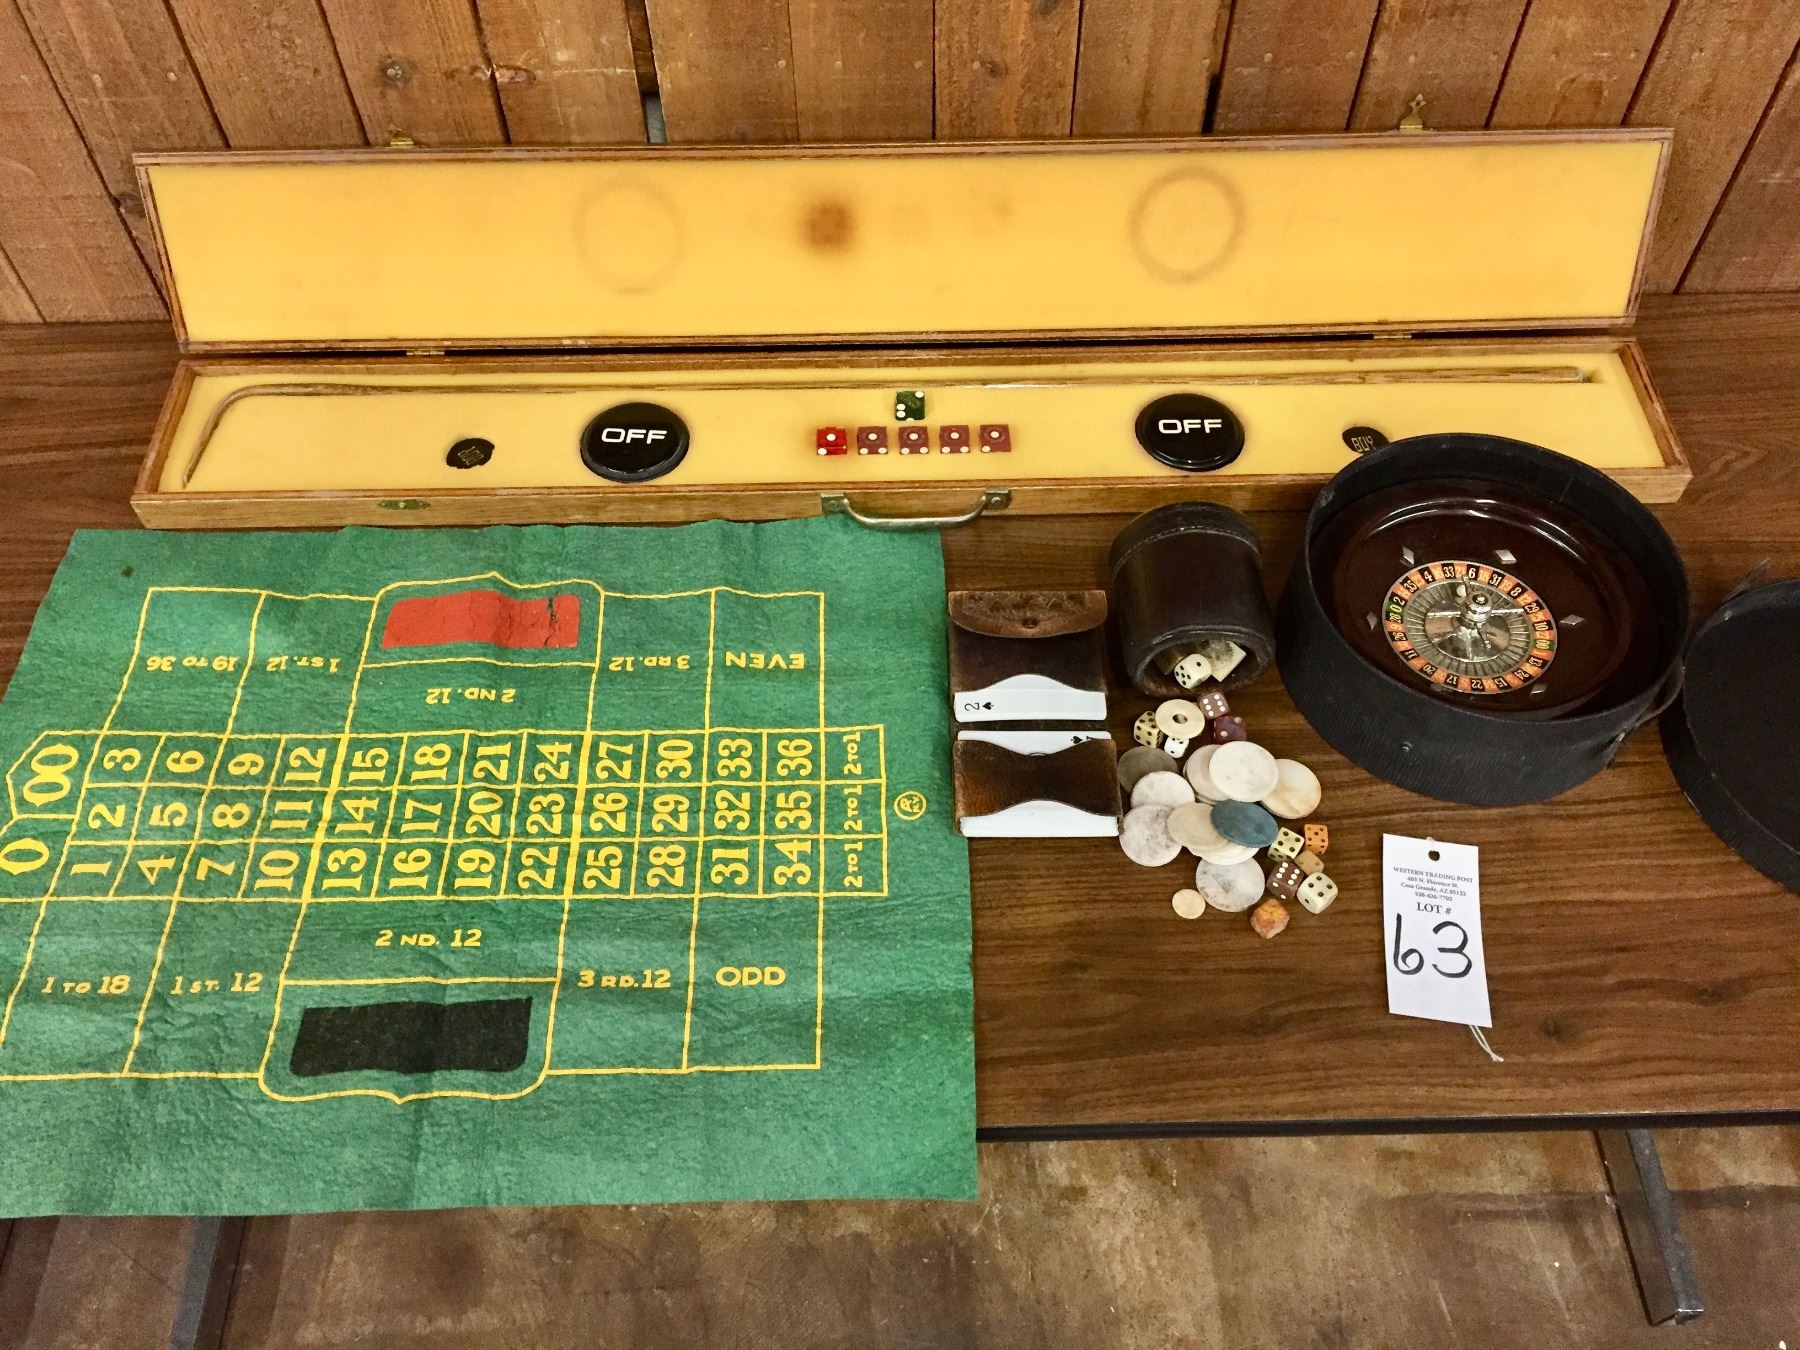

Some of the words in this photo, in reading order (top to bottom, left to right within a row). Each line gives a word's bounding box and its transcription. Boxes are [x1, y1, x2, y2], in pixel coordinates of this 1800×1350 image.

[601, 427, 668, 445] OFF
[1158, 419, 1222, 434] OFF
[1424, 571, 1433, 581] 4
[1444, 566, 1455, 577] 33
[1469, 568, 1476, 579] 6
[1489, 574, 1502, 586] 31
[1404, 581, 1418, 593] 35
[1511, 587, 1522, 597] 8
[1390, 604, 1402, 613] 0
[1394, 597, 1405, 606] 2
[1525, 602, 1539, 614] 29
[1535, 622, 1549, 631] 10
[146, 656, 176, 672] 36
[211, 656, 238, 672] 19
[266, 656, 289, 672] 12
[329, 657, 340, 673] 1
[676, 655, 690, 670] 3
[725, 652, 805, 669] EVEN
[426, 688, 452, 704] 12
[501, 689, 516, 703] 2
[1471, 680, 1483, 689] 22
[964, 702, 980, 711] 2
[103, 748, 141, 770] 3
[166, 749, 204, 773] 6
[227, 752, 264, 775] 9
[284, 746, 325, 781] 12
[348, 747, 389, 782] 15
[410, 743, 451, 782] 18
[472, 742, 511, 781] 21
[533, 742, 571, 782] 24
[596, 741, 633, 779] 27
[655, 739, 693, 779] 30
[716, 738, 752, 779] 33
[776, 738, 812, 776] 36
[21, 743, 79, 805] 00
[88, 803, 125, 828] 2
[148, 802, 188, 827] 5
[212, 802, 250, 828] 8
[270, 799, 312, 829] 11
[335, 797, 379, 832] 14
[400, 798, 442, 832] 17
[465, 790, 503, 835] 20
[526, 792, 564, 834] 23
[589, 791, 627, 832] 26
[651, 793, 688, 832] 29
[713, 790, 750, 830] 32
[775, 790, 811, 829] 35
[0, 837, 49, 874] 0
[517, 846, 559, 888] 22
[582, 845, 622, 888] 25
[646, 844, 686, 887] 28
[711, 847, 748, 884] 31
[773, 837, 812, 885] 34
[69, 861, 111, 875] 1
[136, 855, 176, 884] 4
[196, 857, 235, 880] 7
[254, 849, 299, 890] 10
[322, 847, 367, 890] 13
[389, 848, 431, 888] 16
[454, 848, 495, 888] 19
[1393, 866, 1424, 876] WESTERN
[1425, 871, 1456, 881] TRADING
[1456, 875, 1473, 883] POST
[1417, 902, 1442, 914] LOT
[1445, 907, 1452, 915] #
[374, 929, 393, 947] 2
[451, 928, 481, 947] 12
[1393, 913, 1473, 978] 63
[42, 976, 55, 994] 1
[98, 974, 131, 995] 18
[171, 976, 183, 995] 1
[231, 972, 264, 993] 12
[578, 969, 596, 988] 3
[715, 966, 786, 987] ODD
